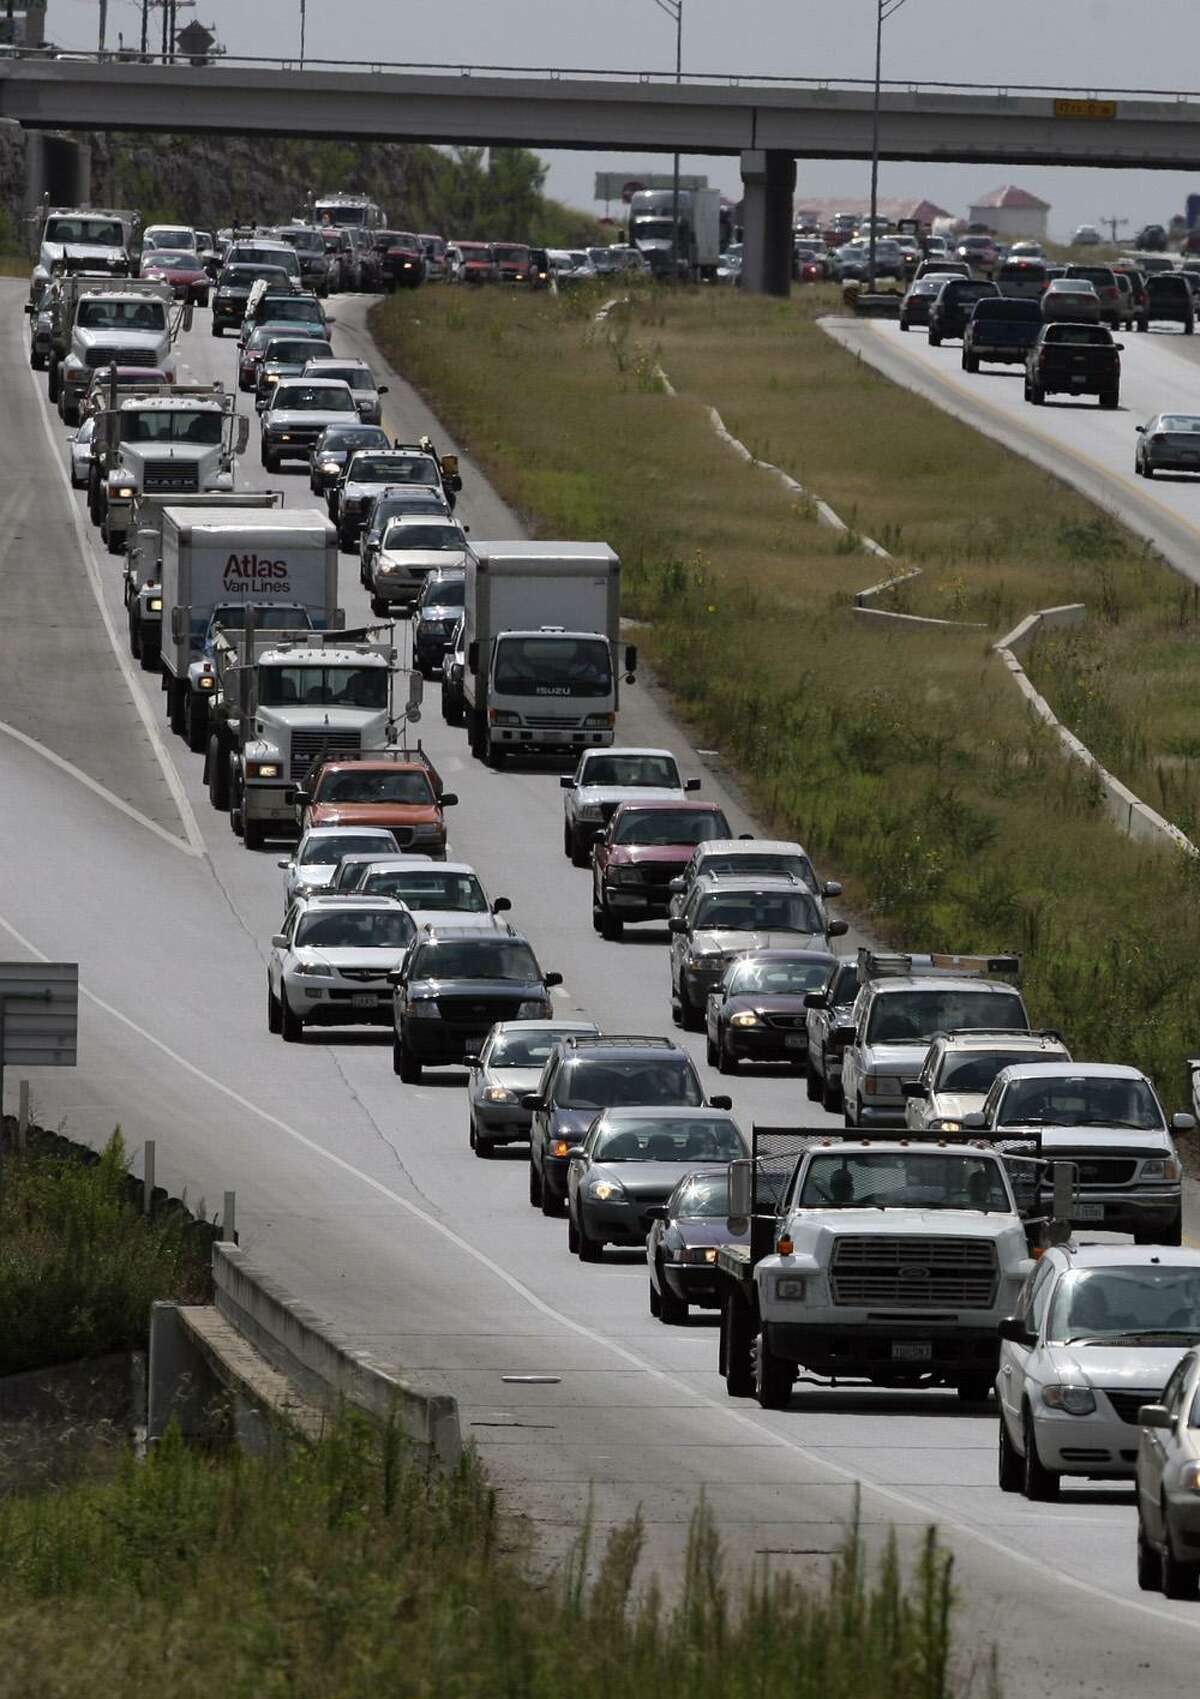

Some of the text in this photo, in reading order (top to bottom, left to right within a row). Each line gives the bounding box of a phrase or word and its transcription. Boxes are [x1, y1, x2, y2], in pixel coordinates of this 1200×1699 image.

[223, 554, 288, 578] Atlas
[223, 580, 290, 592] Van Lines
[536, 687, 571, 695] ISUZU
